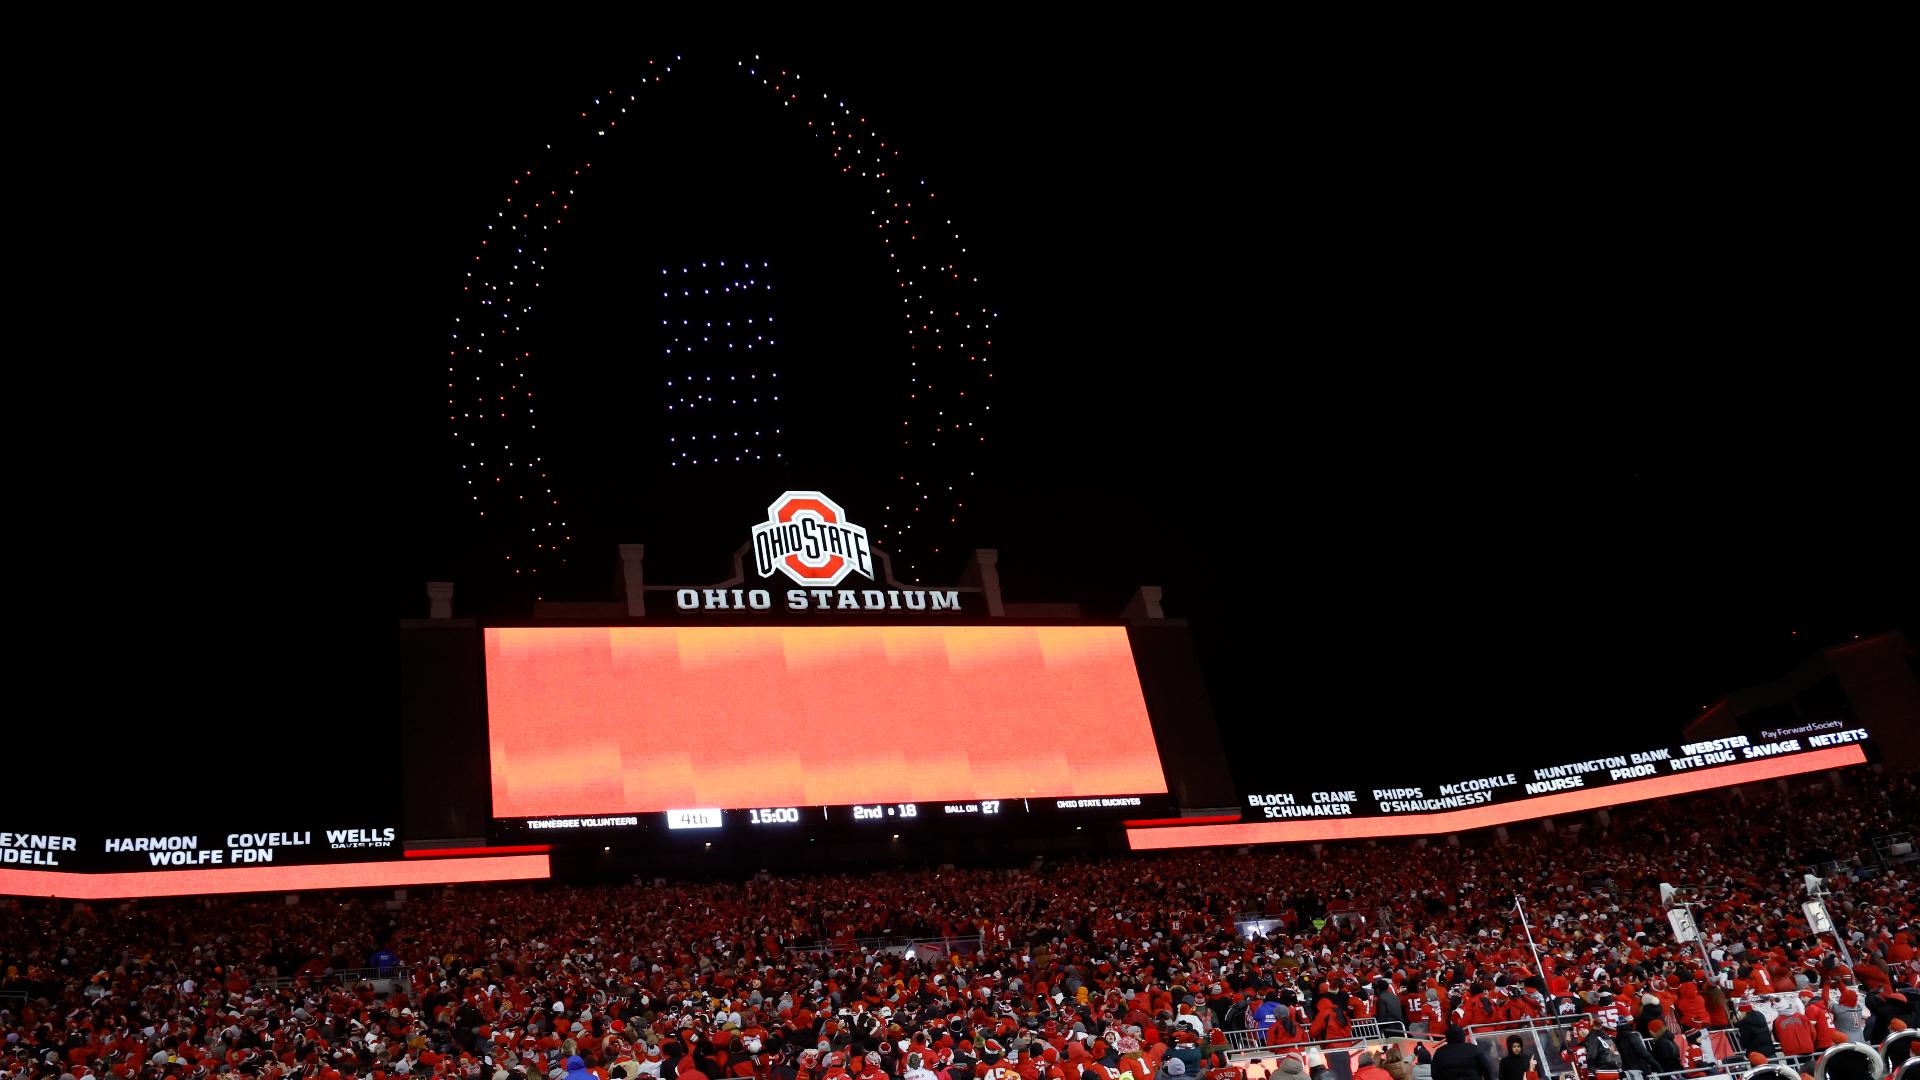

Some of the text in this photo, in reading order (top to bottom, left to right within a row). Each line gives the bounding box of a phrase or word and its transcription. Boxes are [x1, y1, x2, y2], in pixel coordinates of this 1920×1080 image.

[756, 517, 871, 577] OHIO STATE
[677, 589, 962, 610] OHIO STADIUM
[1762, 720, 1843, 739] Pay Forward Society
[1808, 728, 1868, 747] NETJETS
[1680, 735, 1750, 756] WEBSTER
[1743, 740, 1801, 758] SAVAGE
[1533, 748, 1671, 780] HUNTINGTON BANK
[1670, 750, 1736, 770] RITE RUG
[1610, 764, 1657, 780] PRIOR
[1439, 774, 1517, 796] McCORKLE
[1525, 776, 1584, 794] NOURSE
[1248, 794, 1295, 806] BLOCH
[1311, 791, 1357, 803] CRANE
[1373, 788, 1423, 800] PHIPPS
[1380, 790, 1492, 812] O'SHAUGHNESSY
[945, 801, 999, 814] BALL ON 27
[1057, 798, 1141, 808] OHIO STATE BUCKEYES
[1264, 804, 1352, 818] SCHUMAKER
[681, 813, 708, 825] 4th
[749, 808, 799, 824] 15:00
[853, 805, 882, 819] 2nd
[898, 804, 917, 817] 18
[527, 817, 638, 829] TENNESSEE VOLUNTEERS
[227, 831, 311, 848] COVELLI
[326, 828, 395, 843] WELLS
[105, 836, 198, 852] HARMON
[149, 848, 273, 866] WOLFE FDN
